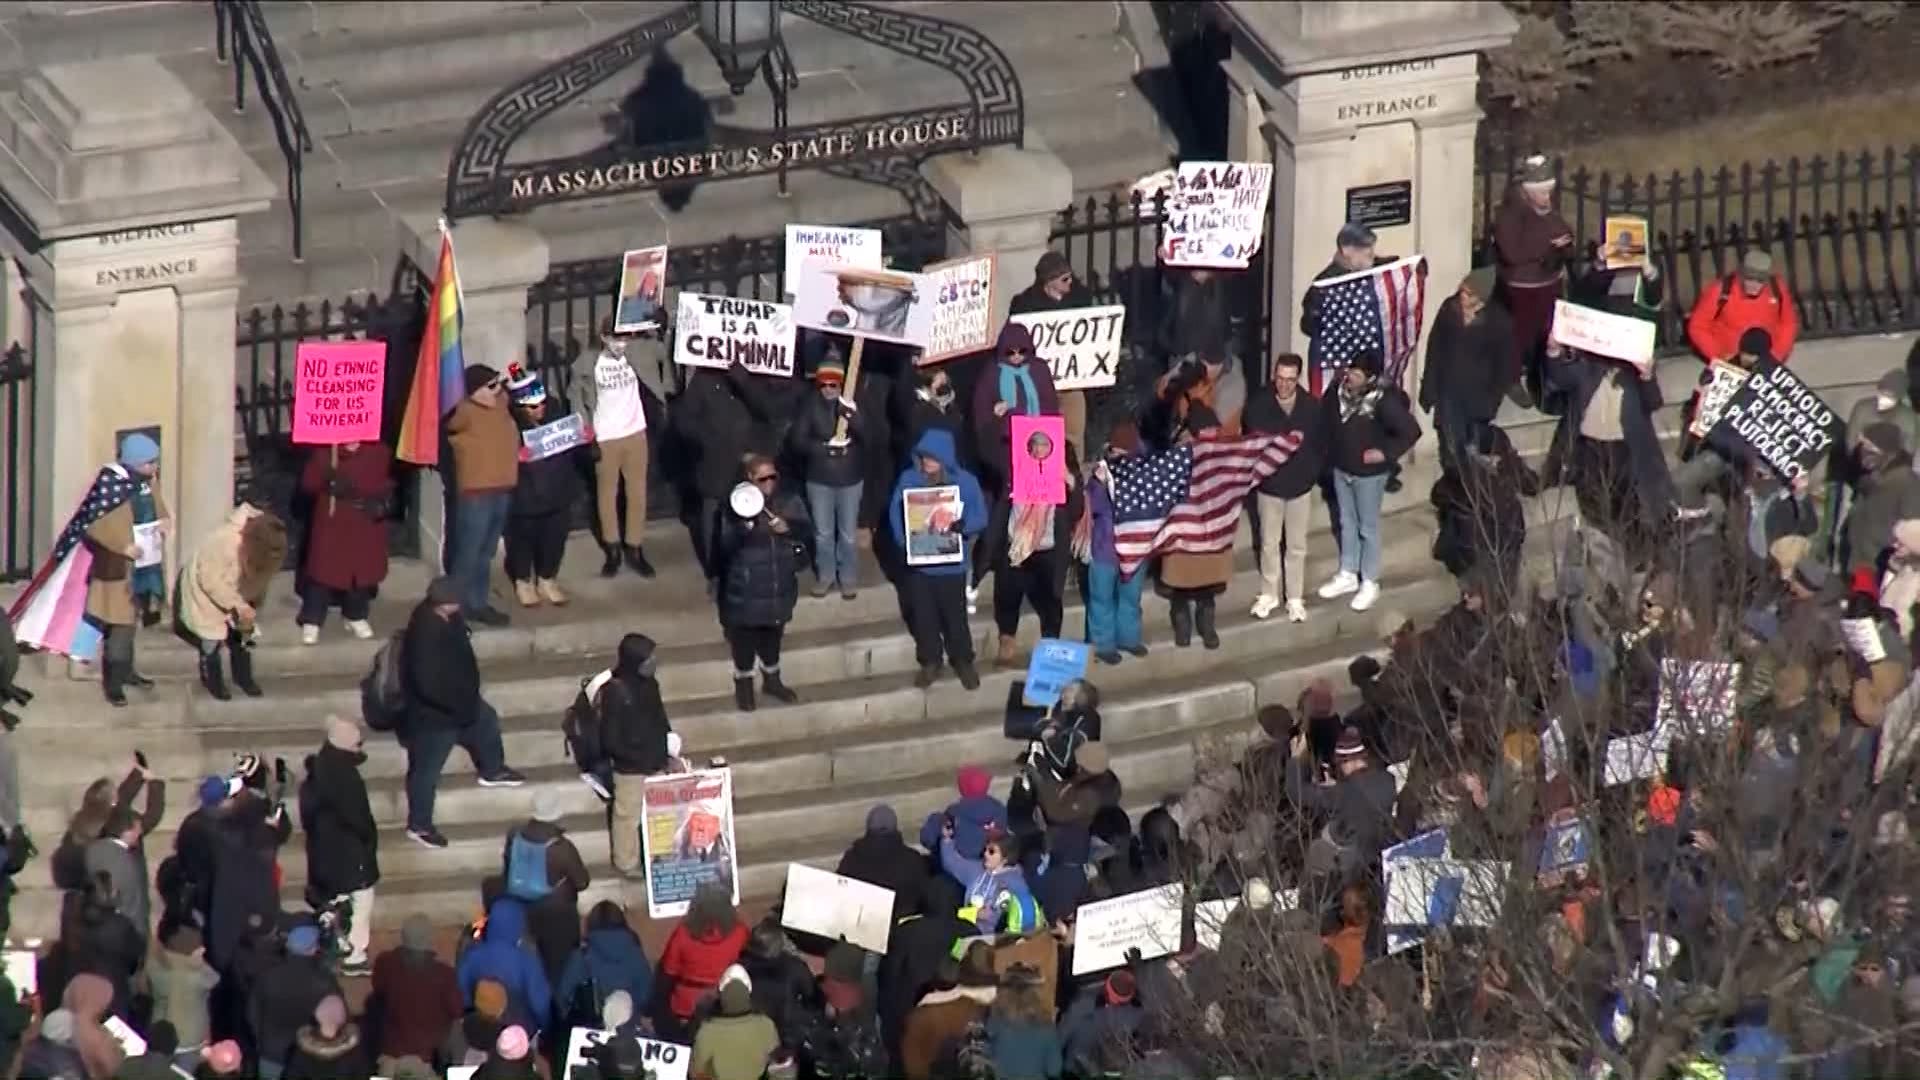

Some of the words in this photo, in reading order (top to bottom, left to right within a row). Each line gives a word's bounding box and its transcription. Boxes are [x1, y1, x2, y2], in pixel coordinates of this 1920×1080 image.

[1337, 95, 1438, 120] ENTRANCE
[770, 133, 855, 165] STATE
[866, 116, 966, 150] HOUSE
[96, 258, 197, 286] ENTRANCE
[698, 297, 776, 320] TRUMP
[721, 319, 737, 334] IS
[743, 321, 759, 336] A
[1031, 313, 1122, 350] OYCOTT
[686, 334, 791, 372] CRIMINAL
[304, 359, 328, 378] NO
[335, 361, 378, 376] ETHNIC
[306, 379, 376, 394] CLEANSING
[1771, 365, 1832, 427] UPHOLD
[315, 398, 340, 410] FOR
[347, 397, 364, 410] US
[1749, 373, 1833, 452] DEMOCRACY
[1724, 405, 1808, 479] PLUTOCRACY
[1747, 400, 1811, 457] REJECT
[643, 1041, 678, 1064] NO
